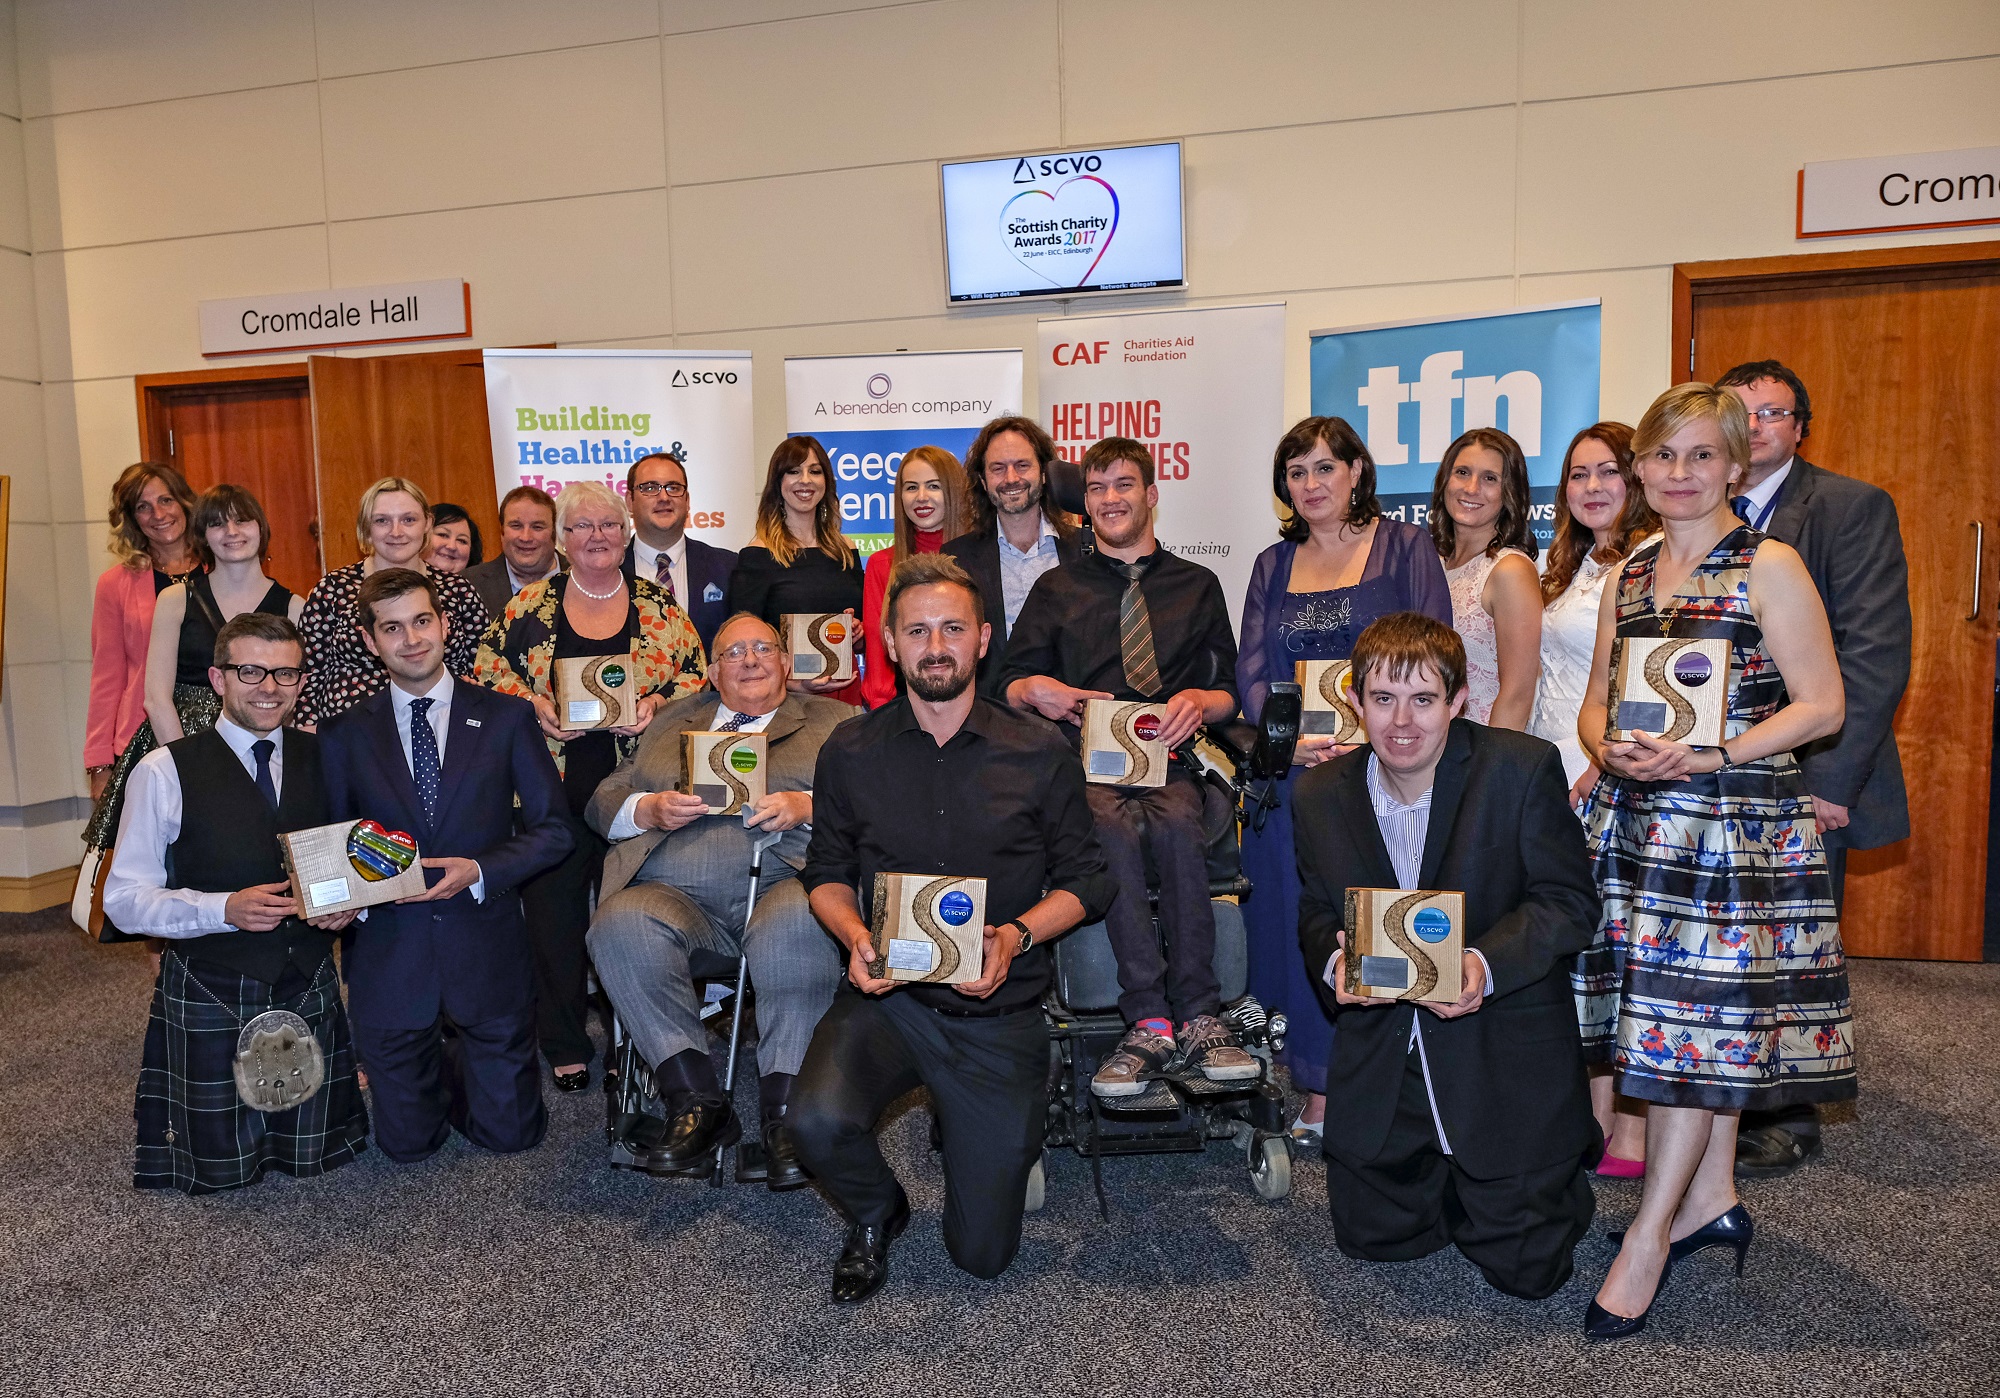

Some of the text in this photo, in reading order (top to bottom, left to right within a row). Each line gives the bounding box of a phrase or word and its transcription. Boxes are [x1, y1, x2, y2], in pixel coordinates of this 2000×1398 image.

[1040, 155, 1102, 177] SCVO
[1879, 173, 2000, 207] Crom
[1008, 216, 1108, 235] Scottish Charity
[1014, 230, 1097, 248] Awards 2017
[1063, 247, 1094, 255] Edinburgh
[241, 295, 418, 335] Cromdale Hall
[1124, 336, 1195, 350] Charities Aid
[1052, 341, 1110, 366] CAF
[1124, 350, 1187, 363] Foundation
[692, 372, 738, 384] SCVO
[814, 399, 993, 416] A benenden company
[1358, 350, 1542, 466] tfn
[515, 406, 651, 437] Building
[1052, 400, 1161, 441] HELPING
[1181, 541, 1231, 557] raising
